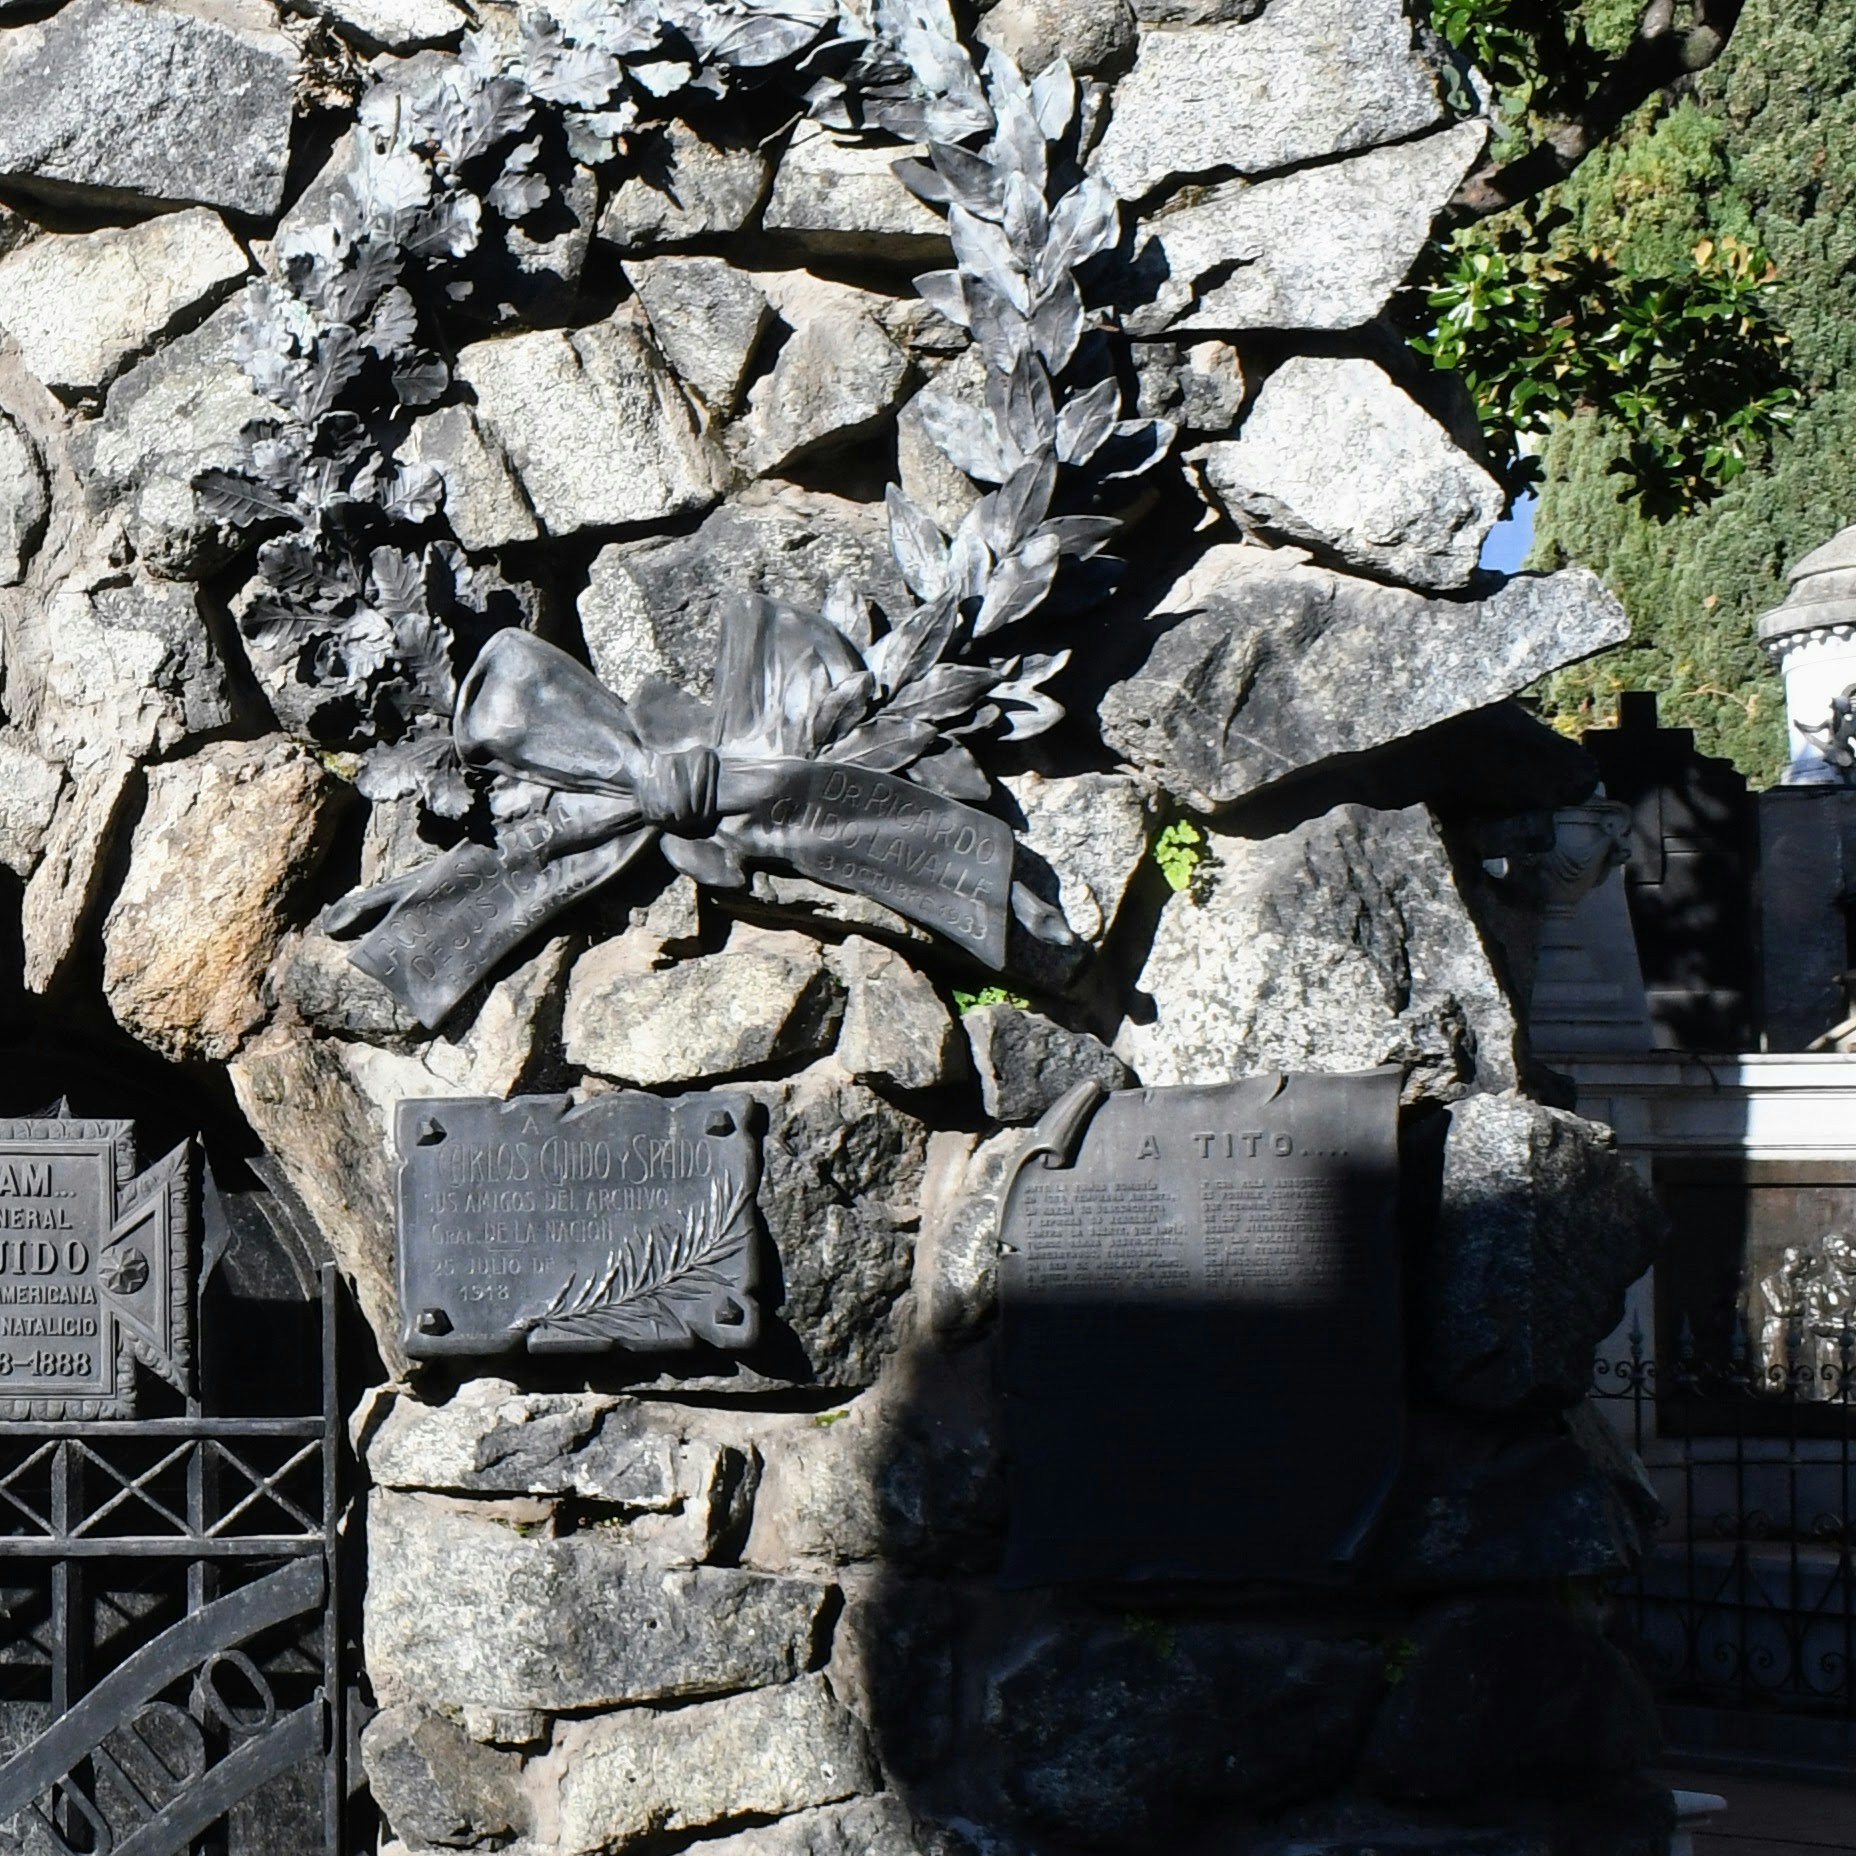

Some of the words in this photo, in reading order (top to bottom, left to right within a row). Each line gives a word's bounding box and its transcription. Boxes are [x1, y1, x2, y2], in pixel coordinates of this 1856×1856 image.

[520, 1115, 540, 1136] A
[1136, 1134, 1160, 1161] A
[539, 1134, 612, 1187] GUIDO
[464, 1191, 537, 1214] AMIGOS
[545, 1190, 581, 1212] DEL
[586, 1188, 670, 1212] ARCHIVO
[483, 1221, 509, 1244] DE
[514, 1221, 538, 1243] LA
[468, 1257, 522, 1277] JULIO
[532, 1257, 556, 1275] DE
[459, 1284, 510, 1303] 1918
[0, 1316, 98, 1337] NATALICIO
